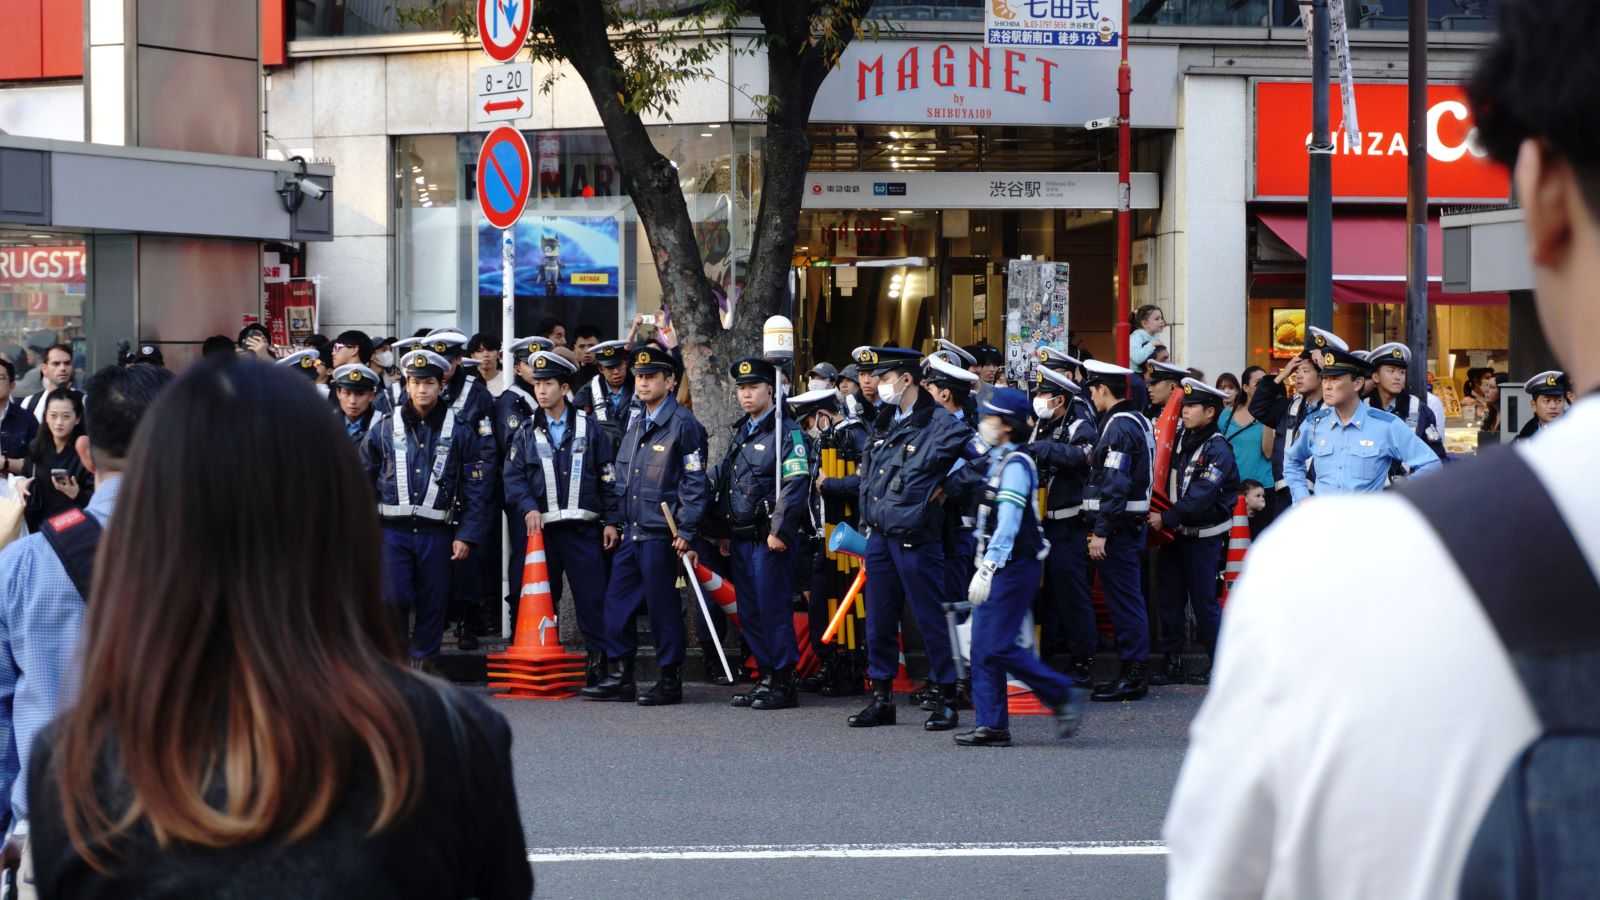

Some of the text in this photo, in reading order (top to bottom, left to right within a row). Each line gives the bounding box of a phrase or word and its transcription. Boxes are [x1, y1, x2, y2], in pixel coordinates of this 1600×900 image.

[1024, 0, 1099, 20] 七田式
[990, 31, 1097, 45] 渋谷駅新南口 徒歩1分
[857, 44, 1059, 102] MAGNET
[953, 93, 965, 106] by
[926, 107, 992, 119] SHIBUYA109
[1305, 131, 1408, 156] INZA
[990, 181, 1041, 198] 渋谷駅
[0, 250, 86, 278] RUGST
